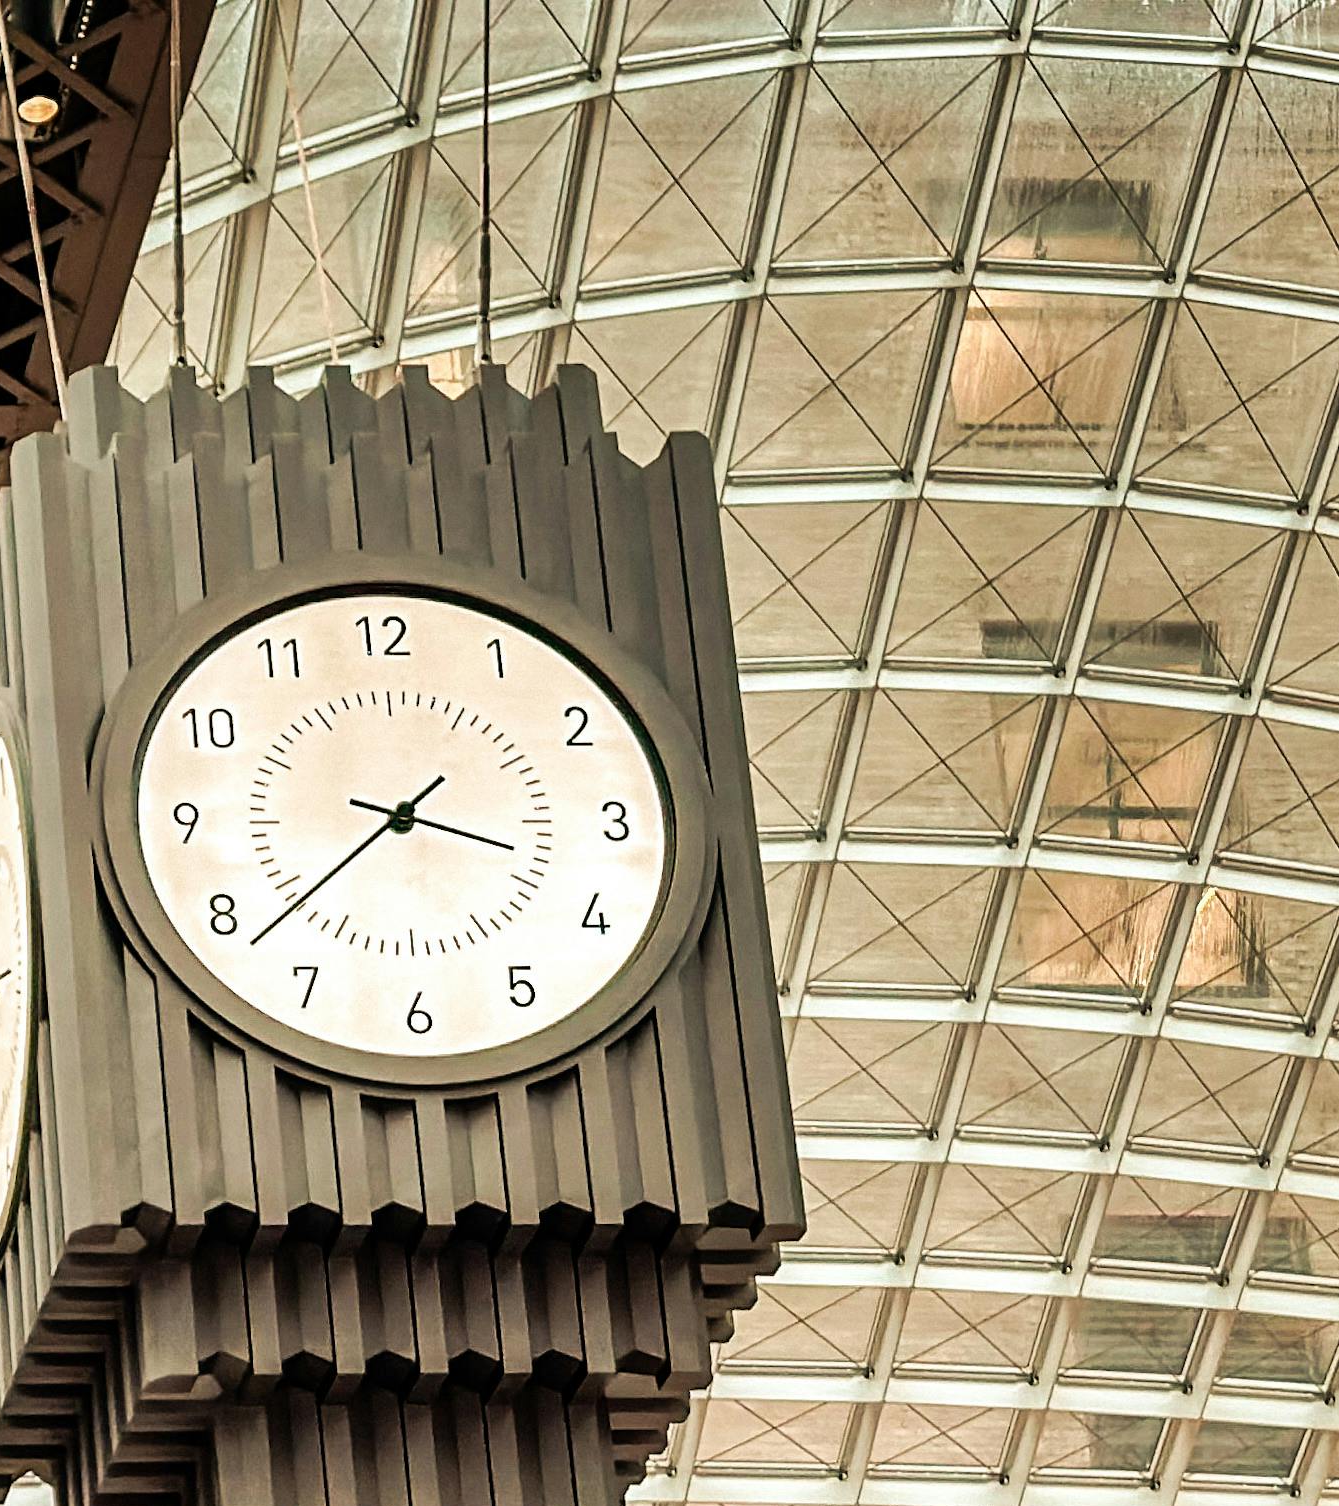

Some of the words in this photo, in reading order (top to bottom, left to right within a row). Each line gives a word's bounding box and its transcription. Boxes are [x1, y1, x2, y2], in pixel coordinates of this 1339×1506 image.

[355, 616, 411, 656] 12
[257, 638, 301, 679] 11
[486, 638, 505, 679] 1
[182, 708, 235, 749] 10
[564, 706, 594, 747] 2
[173, 802, 199, 844] 9
[601, 801, 631, 842] 3
[209, 893, 238, 936] 8
[581, 892, 611, 935] 4
[292, 966, 319, 1009] 7
[508, 965, 536, 1008] 5
[406, 991, 433, 1035] 6
